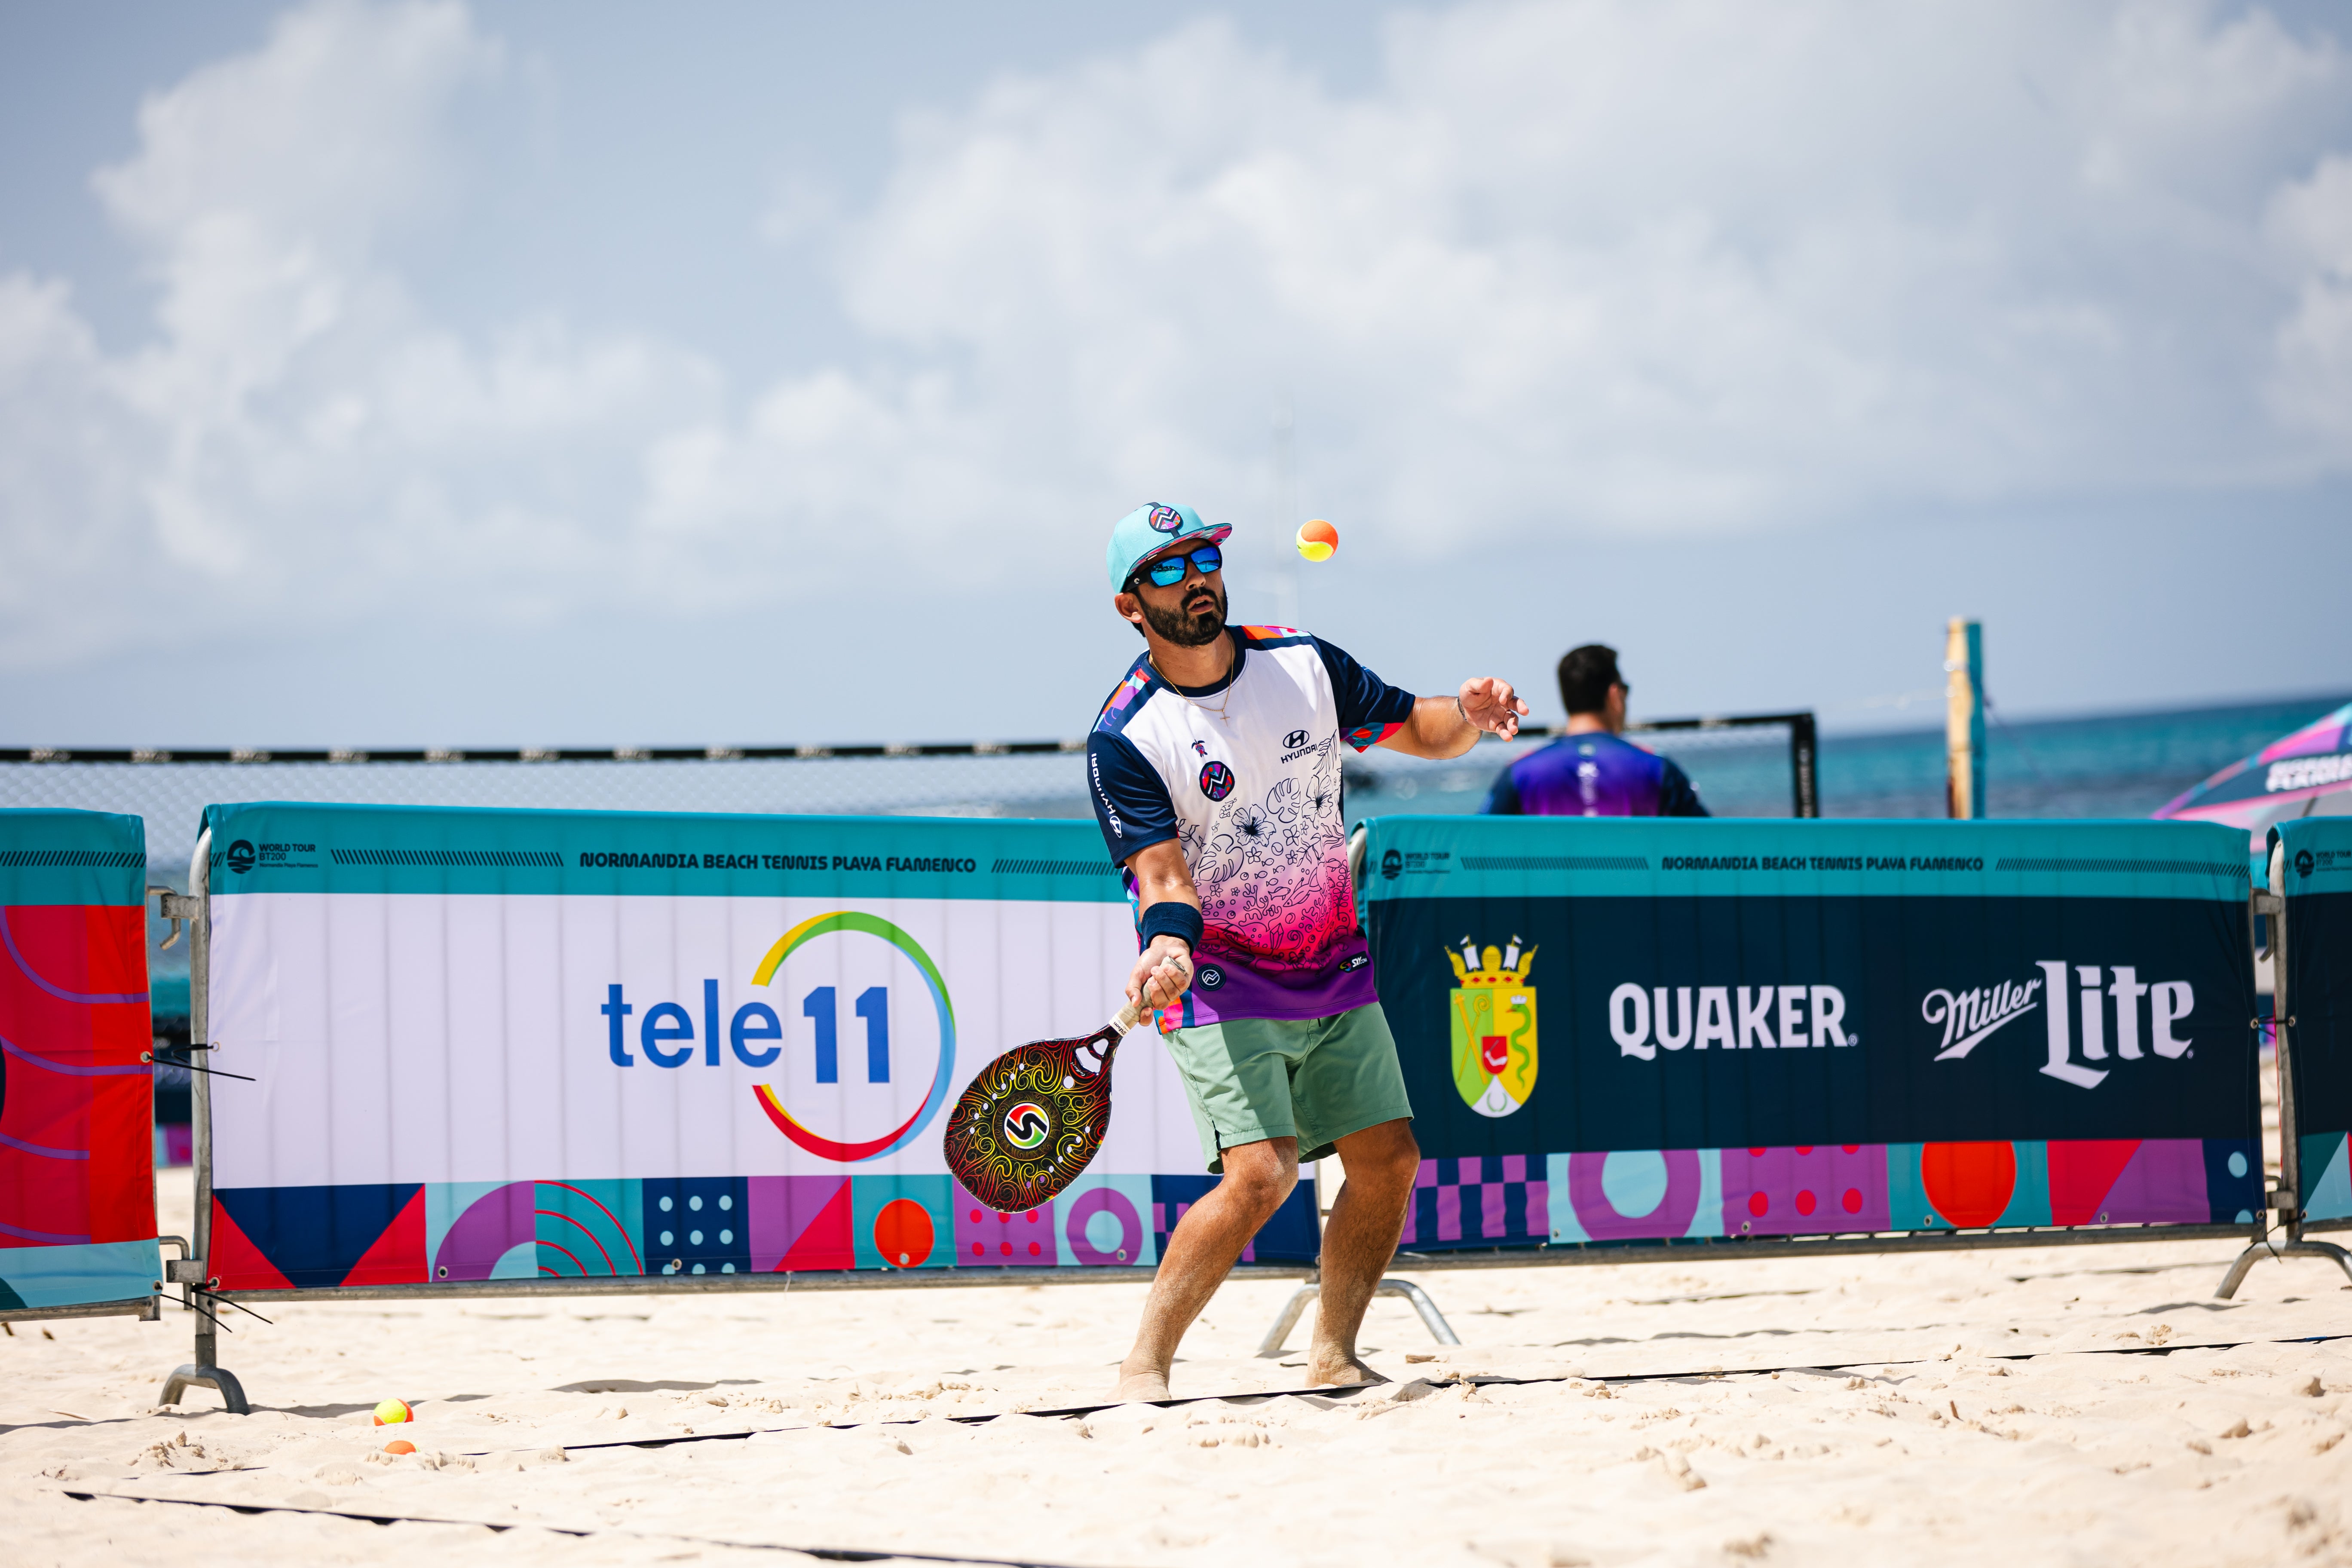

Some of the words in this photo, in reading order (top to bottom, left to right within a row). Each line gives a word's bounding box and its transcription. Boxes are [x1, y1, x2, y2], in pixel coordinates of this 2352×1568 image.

[1280, 744, 1318, 764] HYUNDAI
[259, 844, 291, 852] WORLD
[292, 844, 316, 852] TOUR
[259, 852, 287, 861] BT200
[580, 852, 699, 869] NORMANDIA
[703, 854, 758, 869] BEACH
[761, 855, 828, 870] TENNIS
[832, 856, 882, 871] PLAYA
[886, 857, 977, 873] FLAMENCO
[1662, 857, 1758, 870] NORMANDIA
[1762, 857, 1806, 870] BEACH
[1809, 857, 1863, 870] TENNIS
[1866, 857, 1907, 871] PLAYA
[1910, 857, 1984, 871] FLAMENCO
[1922, 978, 2043, 1049] Miller
[2035, 960, 2194, 1089] Lite
